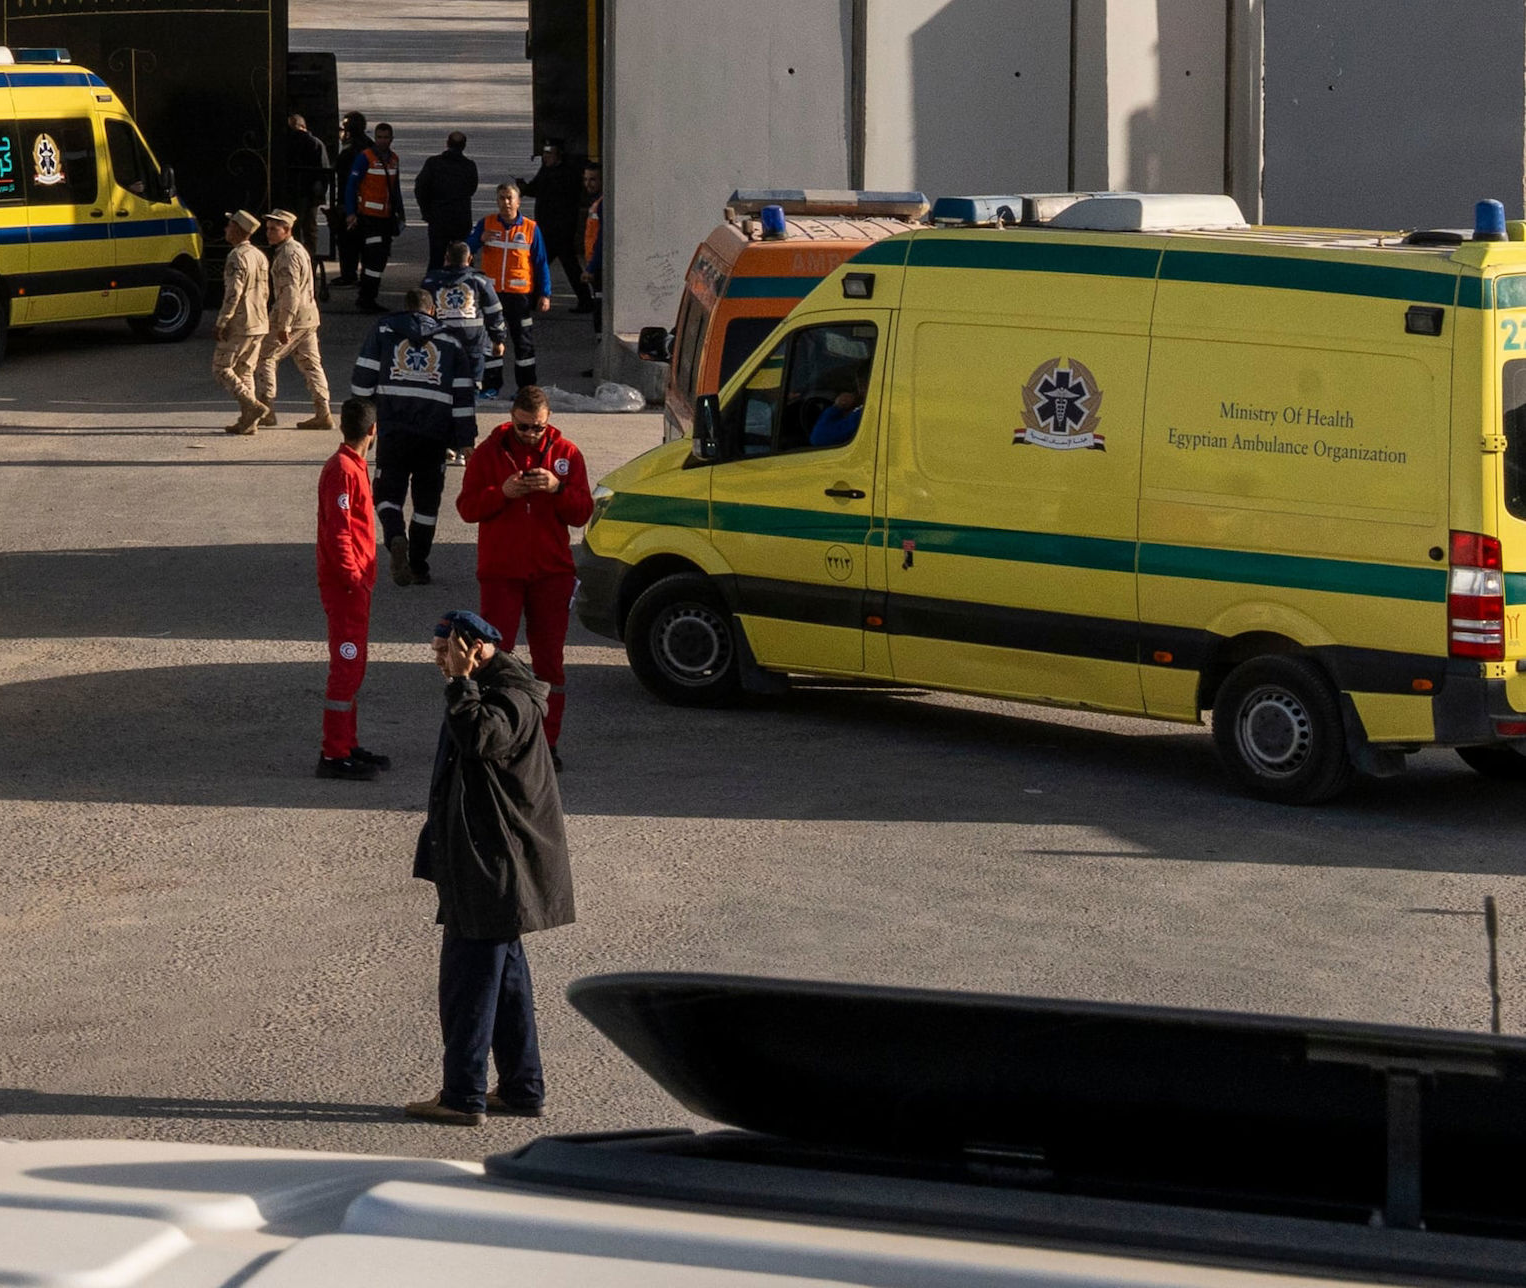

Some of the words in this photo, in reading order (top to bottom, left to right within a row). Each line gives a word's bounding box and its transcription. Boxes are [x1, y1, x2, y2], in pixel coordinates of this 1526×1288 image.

[1219, 401, 1277, 426] Ministry
[1283, 406, 1303, 424] Of
[1307, 409, 1354, 428] Health
[1168, 427, 1227, 450] Egyptian
[1231, 433, 1308, 455] Ambulance
[1314, 440, 1407, 464] Organization
